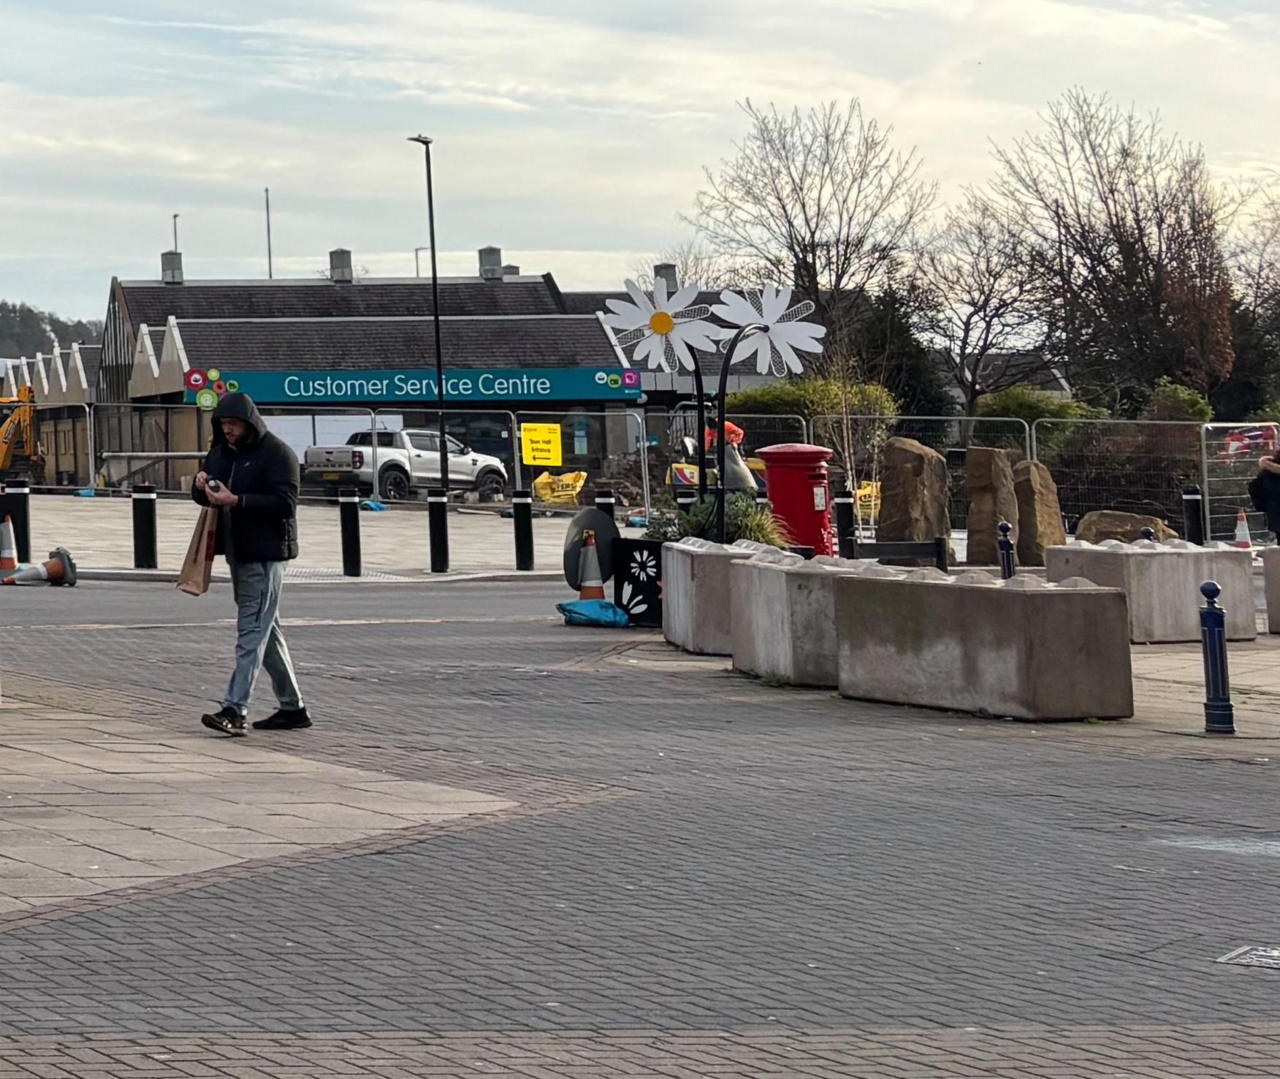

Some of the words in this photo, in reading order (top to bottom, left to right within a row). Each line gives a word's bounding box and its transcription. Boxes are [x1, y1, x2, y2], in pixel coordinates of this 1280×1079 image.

[284, 376, 389, 397] Customer
[394, 375, 473, 396] Service
[478, 374, 551, 395] Centre
